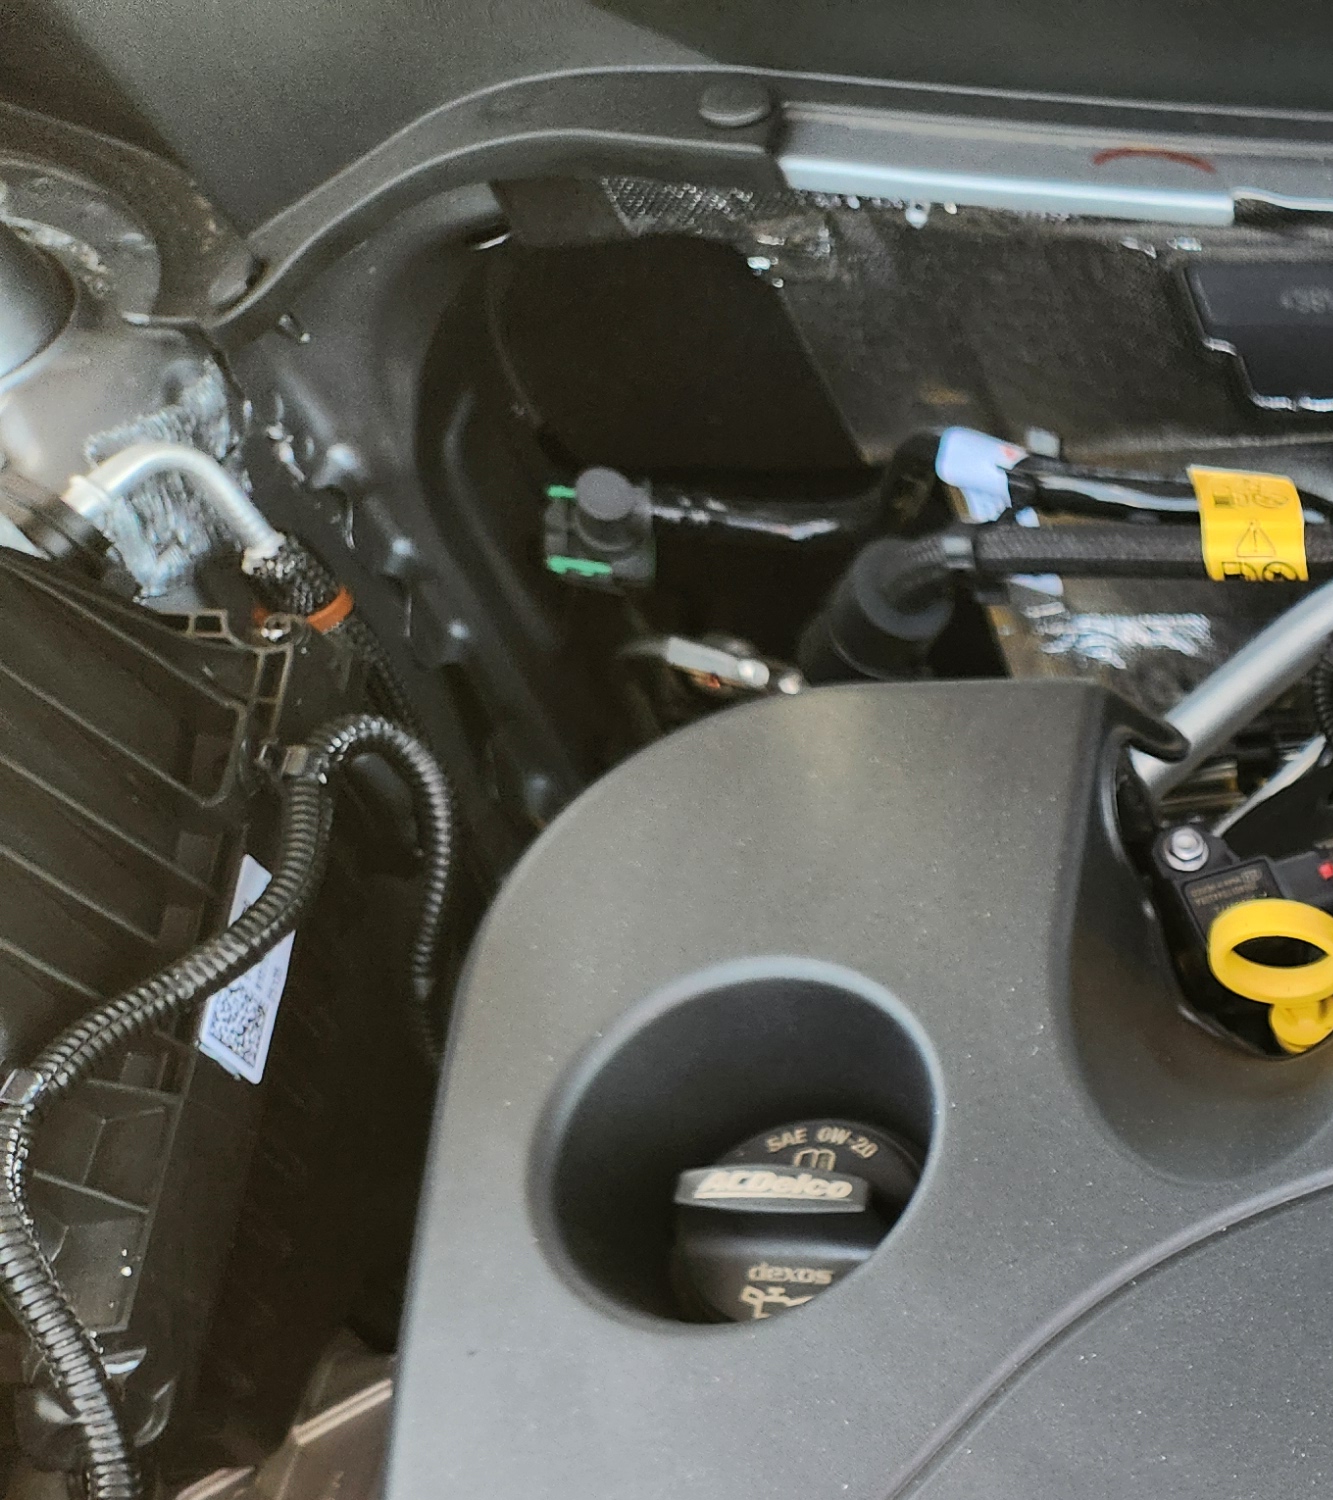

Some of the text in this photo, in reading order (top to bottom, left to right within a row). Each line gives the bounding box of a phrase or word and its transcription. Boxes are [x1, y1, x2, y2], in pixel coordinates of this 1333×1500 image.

[766, 1126, 879, 1159] SAE 0W-20
[698, 1170, 853, 1199] ACDelco
[748, 1261, 834, 1285] dexos
